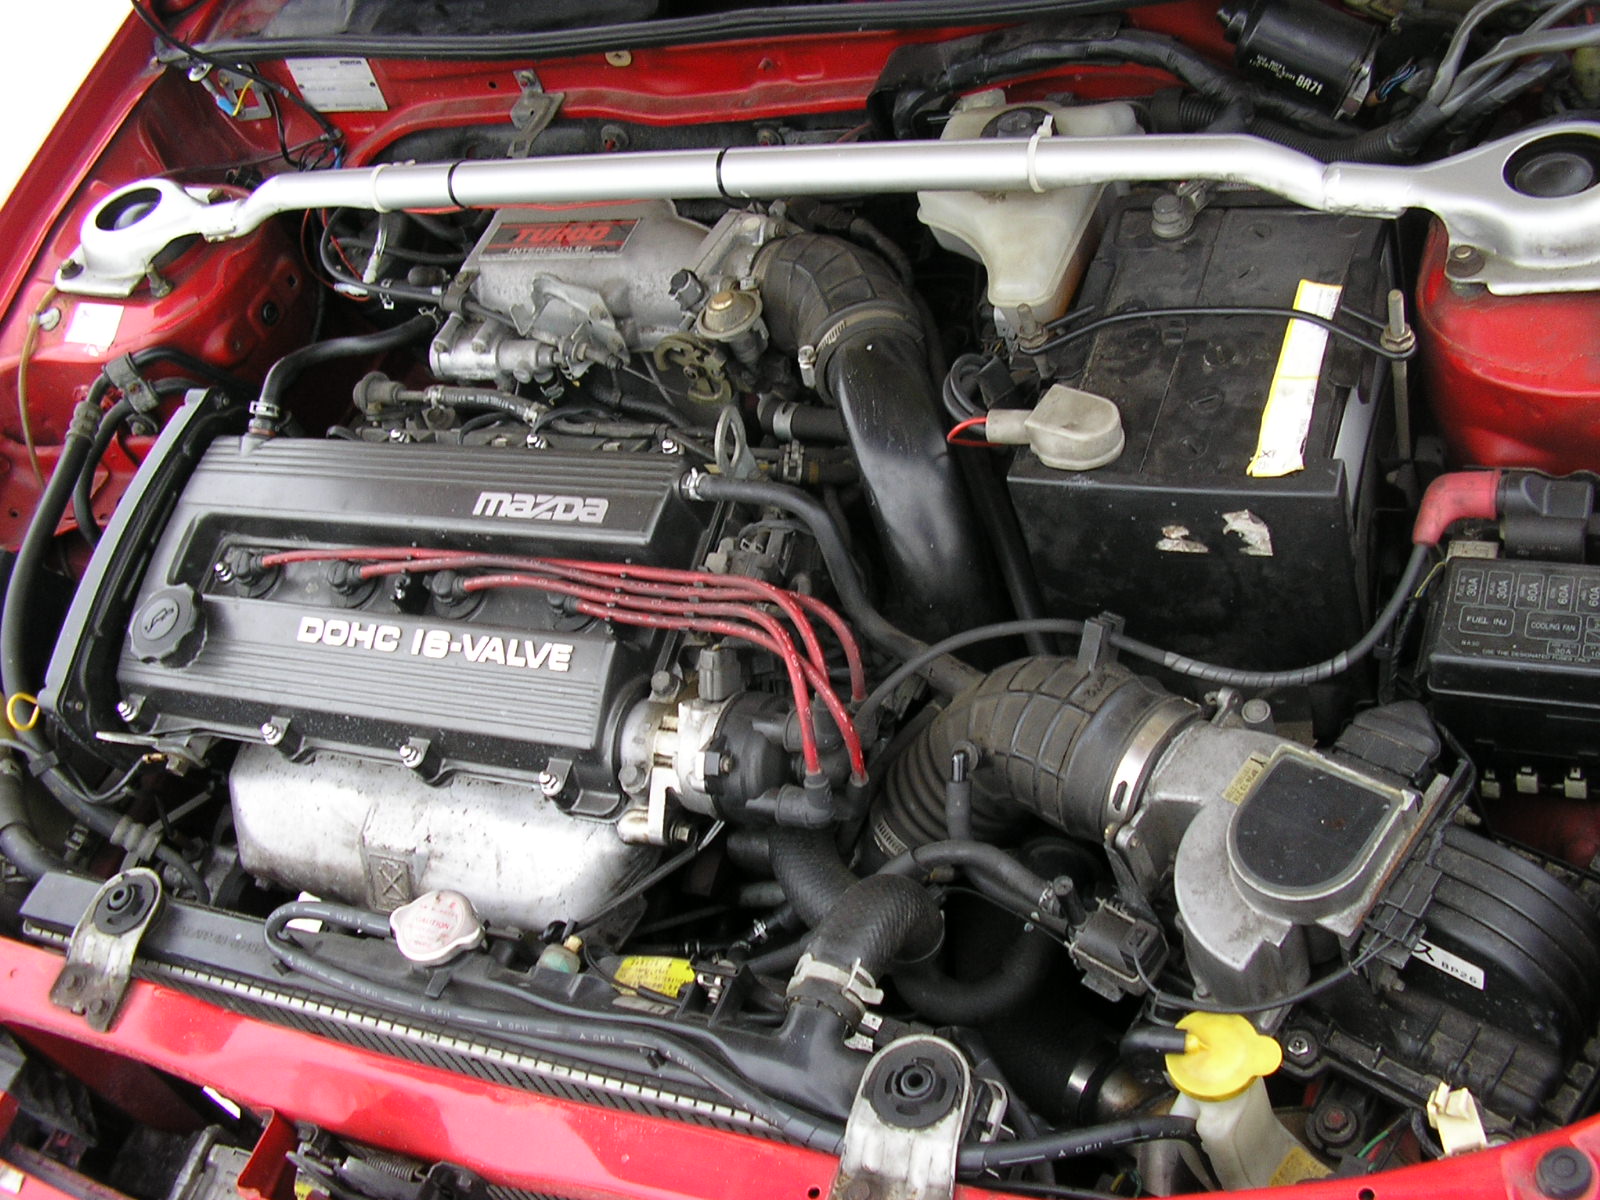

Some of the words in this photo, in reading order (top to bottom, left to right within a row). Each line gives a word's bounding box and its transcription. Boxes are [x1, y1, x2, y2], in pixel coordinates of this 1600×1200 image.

[472, 491, 609, 524] mazda
[1466, 615, 1489, 625] FUEL
[1562, 624, 1577, 633] FAN
[296, 616, 401, 653] DOHC
[410, 627, 574, 673] 16-VALVE
